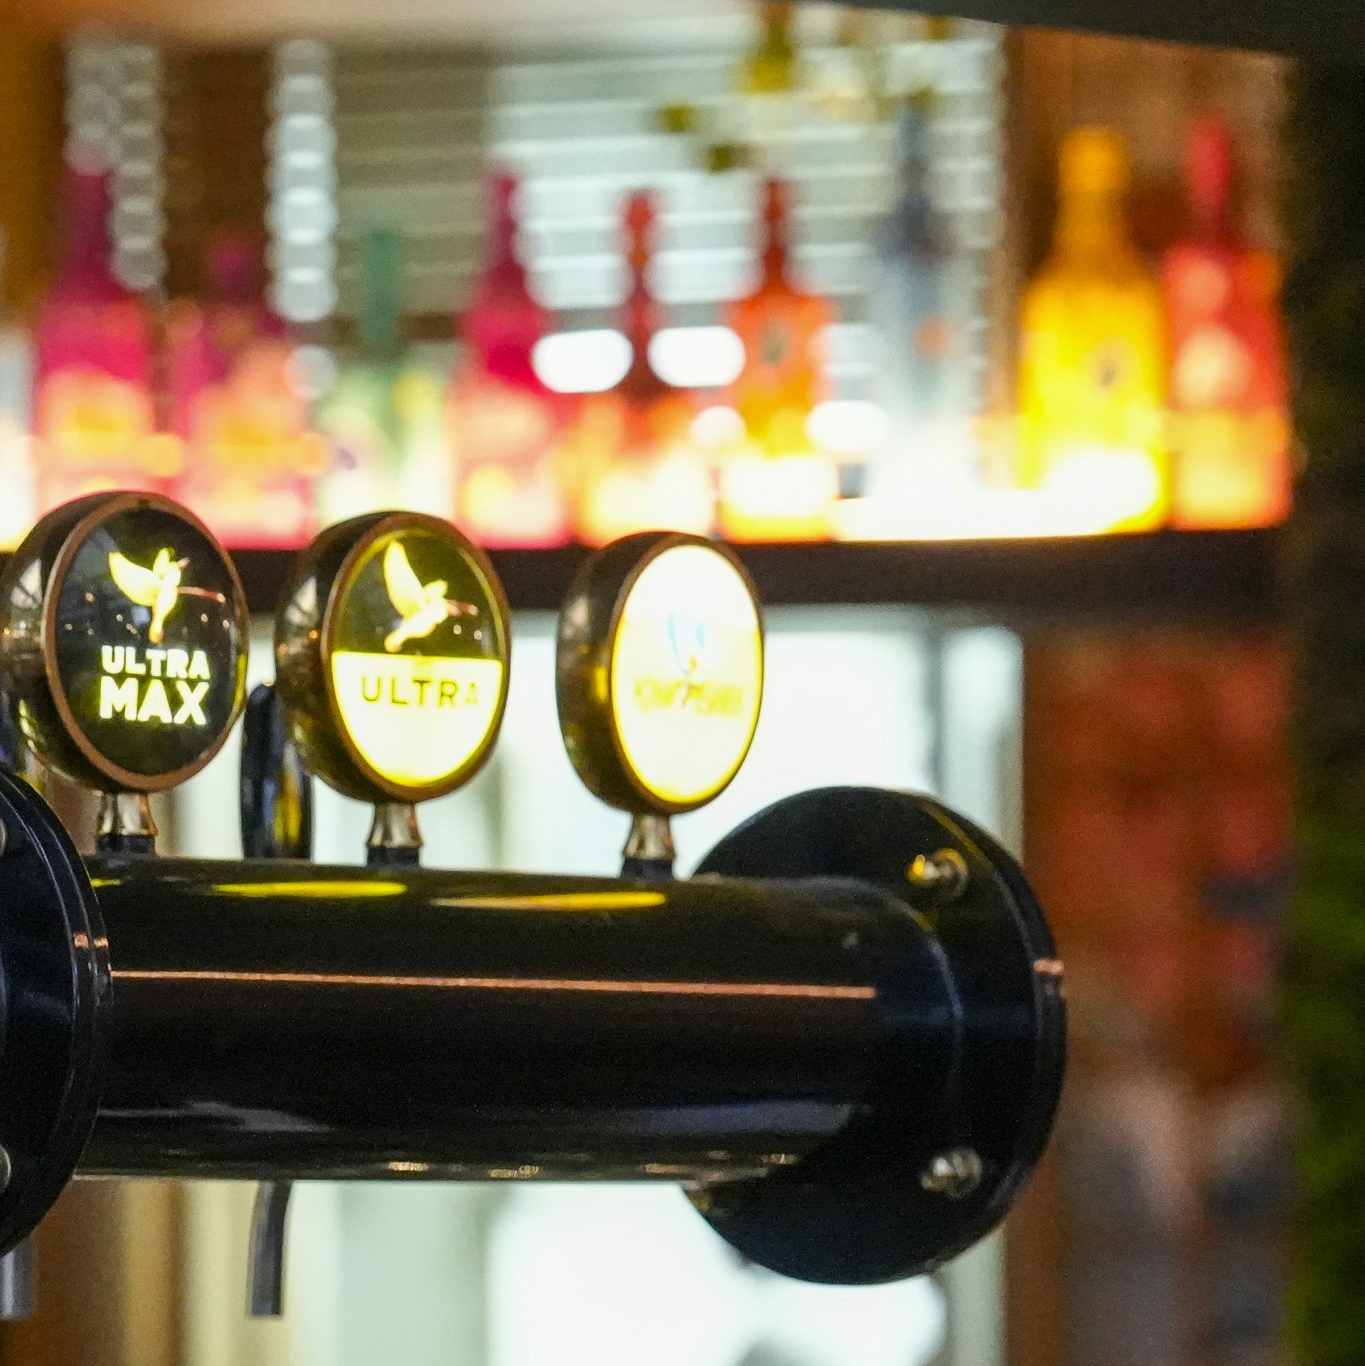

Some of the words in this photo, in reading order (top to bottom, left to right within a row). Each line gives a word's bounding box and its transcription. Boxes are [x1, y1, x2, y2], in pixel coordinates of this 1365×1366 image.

[101, 644, 211, 680] ULTRA
[99, 676, 210, 726] MAX
[361, 675, 479, 708] ULTRA
